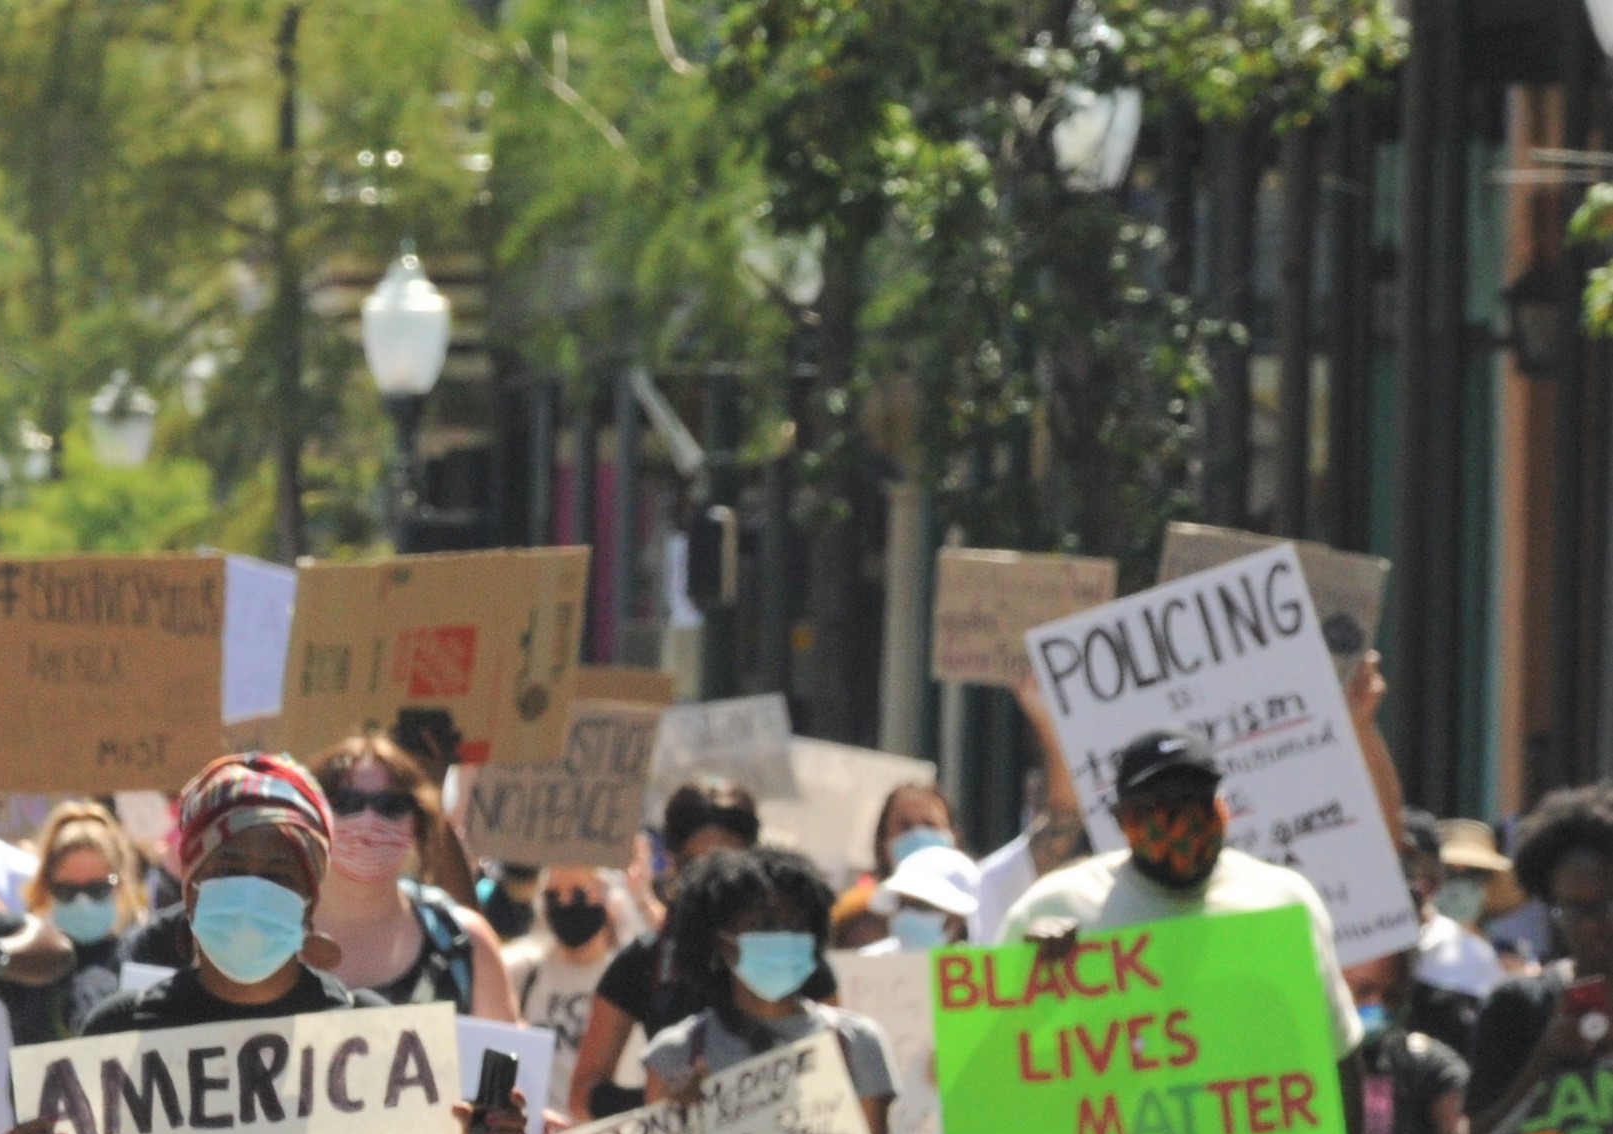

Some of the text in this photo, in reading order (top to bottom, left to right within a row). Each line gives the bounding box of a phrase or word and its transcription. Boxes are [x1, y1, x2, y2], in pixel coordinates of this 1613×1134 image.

[1040, 560, 1302, 717] POLICING
[939, 934, 1162, 1011] BLACK
[1017, 1009, 1200, 1083] LIVES
